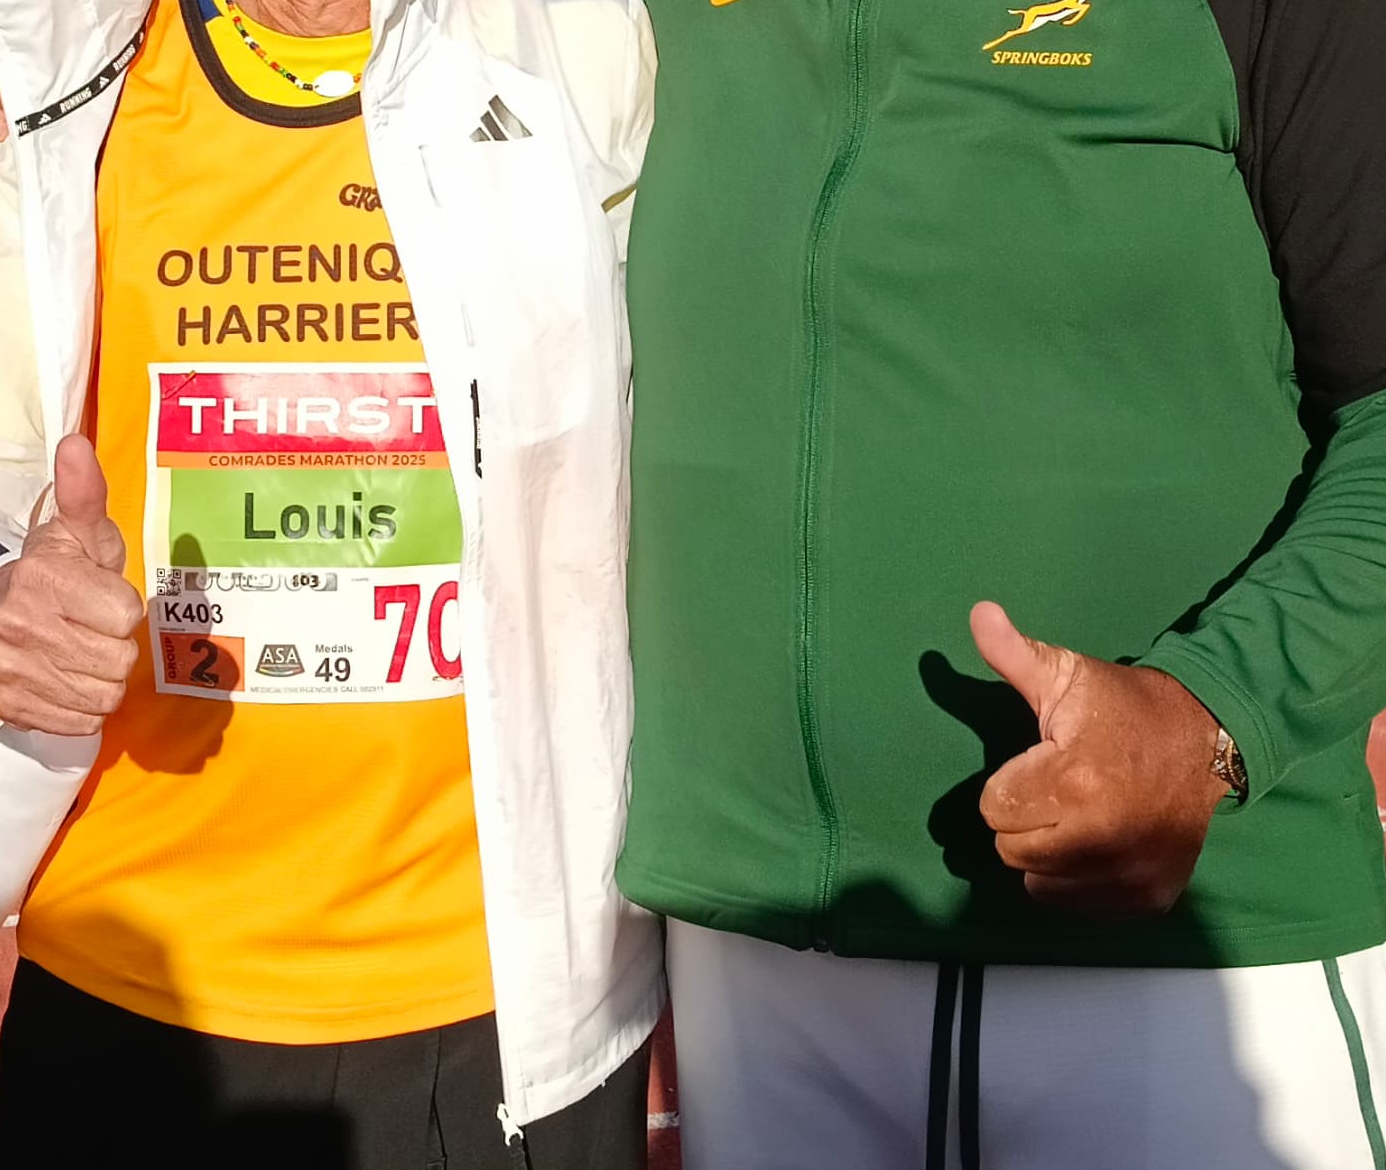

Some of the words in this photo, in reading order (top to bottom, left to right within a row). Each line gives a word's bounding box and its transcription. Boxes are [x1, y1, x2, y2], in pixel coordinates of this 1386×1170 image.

[991, 50, 1093, 66] SPRINGBOKS
[157, 242, 404, 287] OUTENIQ
[177, 301, 420, 346] HARRIER
[178, 396, 438, 435] THIRST
[209, 455, 295, 466] COMRADES
[300, 454, 387, 466] MARATHON
[391, 454, 426, 466] 2025
[244, 491, 397, 540] Louis
[164, 601, 224, 624] K403
[165, 637, 177, 679] GROUP
[190, 638, 219, 686] 2
[262, 647, 298, 664] ASA
[315, 644, 354, 653] Medals
[314, 657, 351, 682] 49
